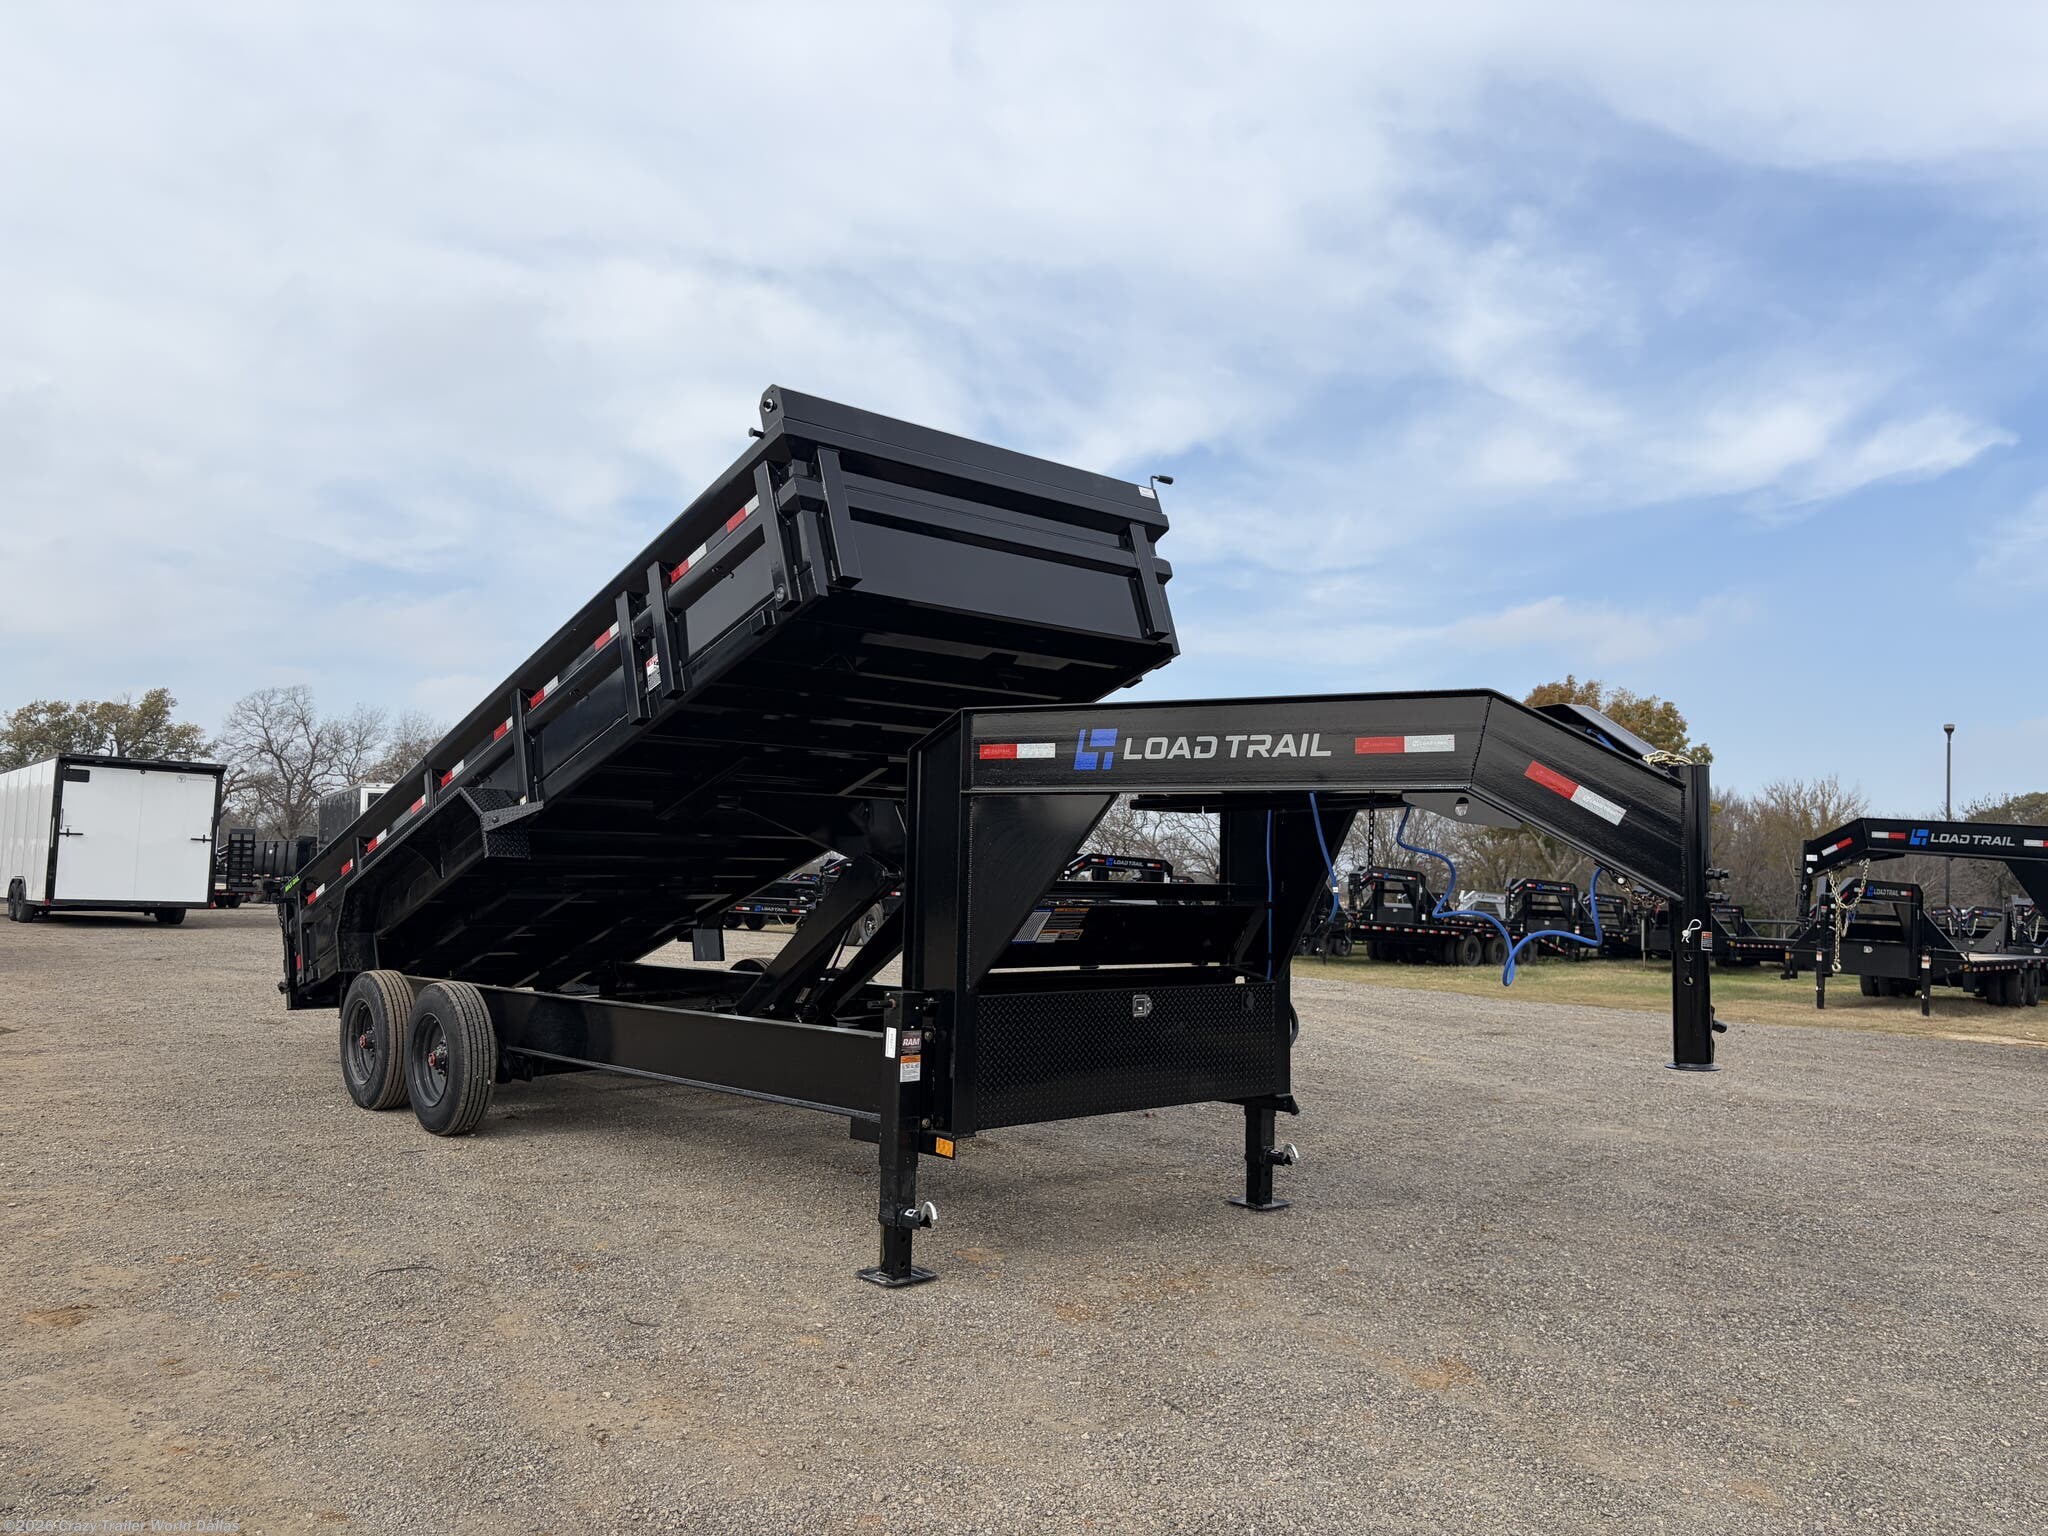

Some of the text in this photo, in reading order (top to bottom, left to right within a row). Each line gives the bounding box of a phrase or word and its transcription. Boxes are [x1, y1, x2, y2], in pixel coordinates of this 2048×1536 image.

[1123, 733, 1332, 760] LOAD TRAIL
[1930, 833, 2015, 847] LOAD TRAIL
[902, 1038, 920, 1046] RAM
